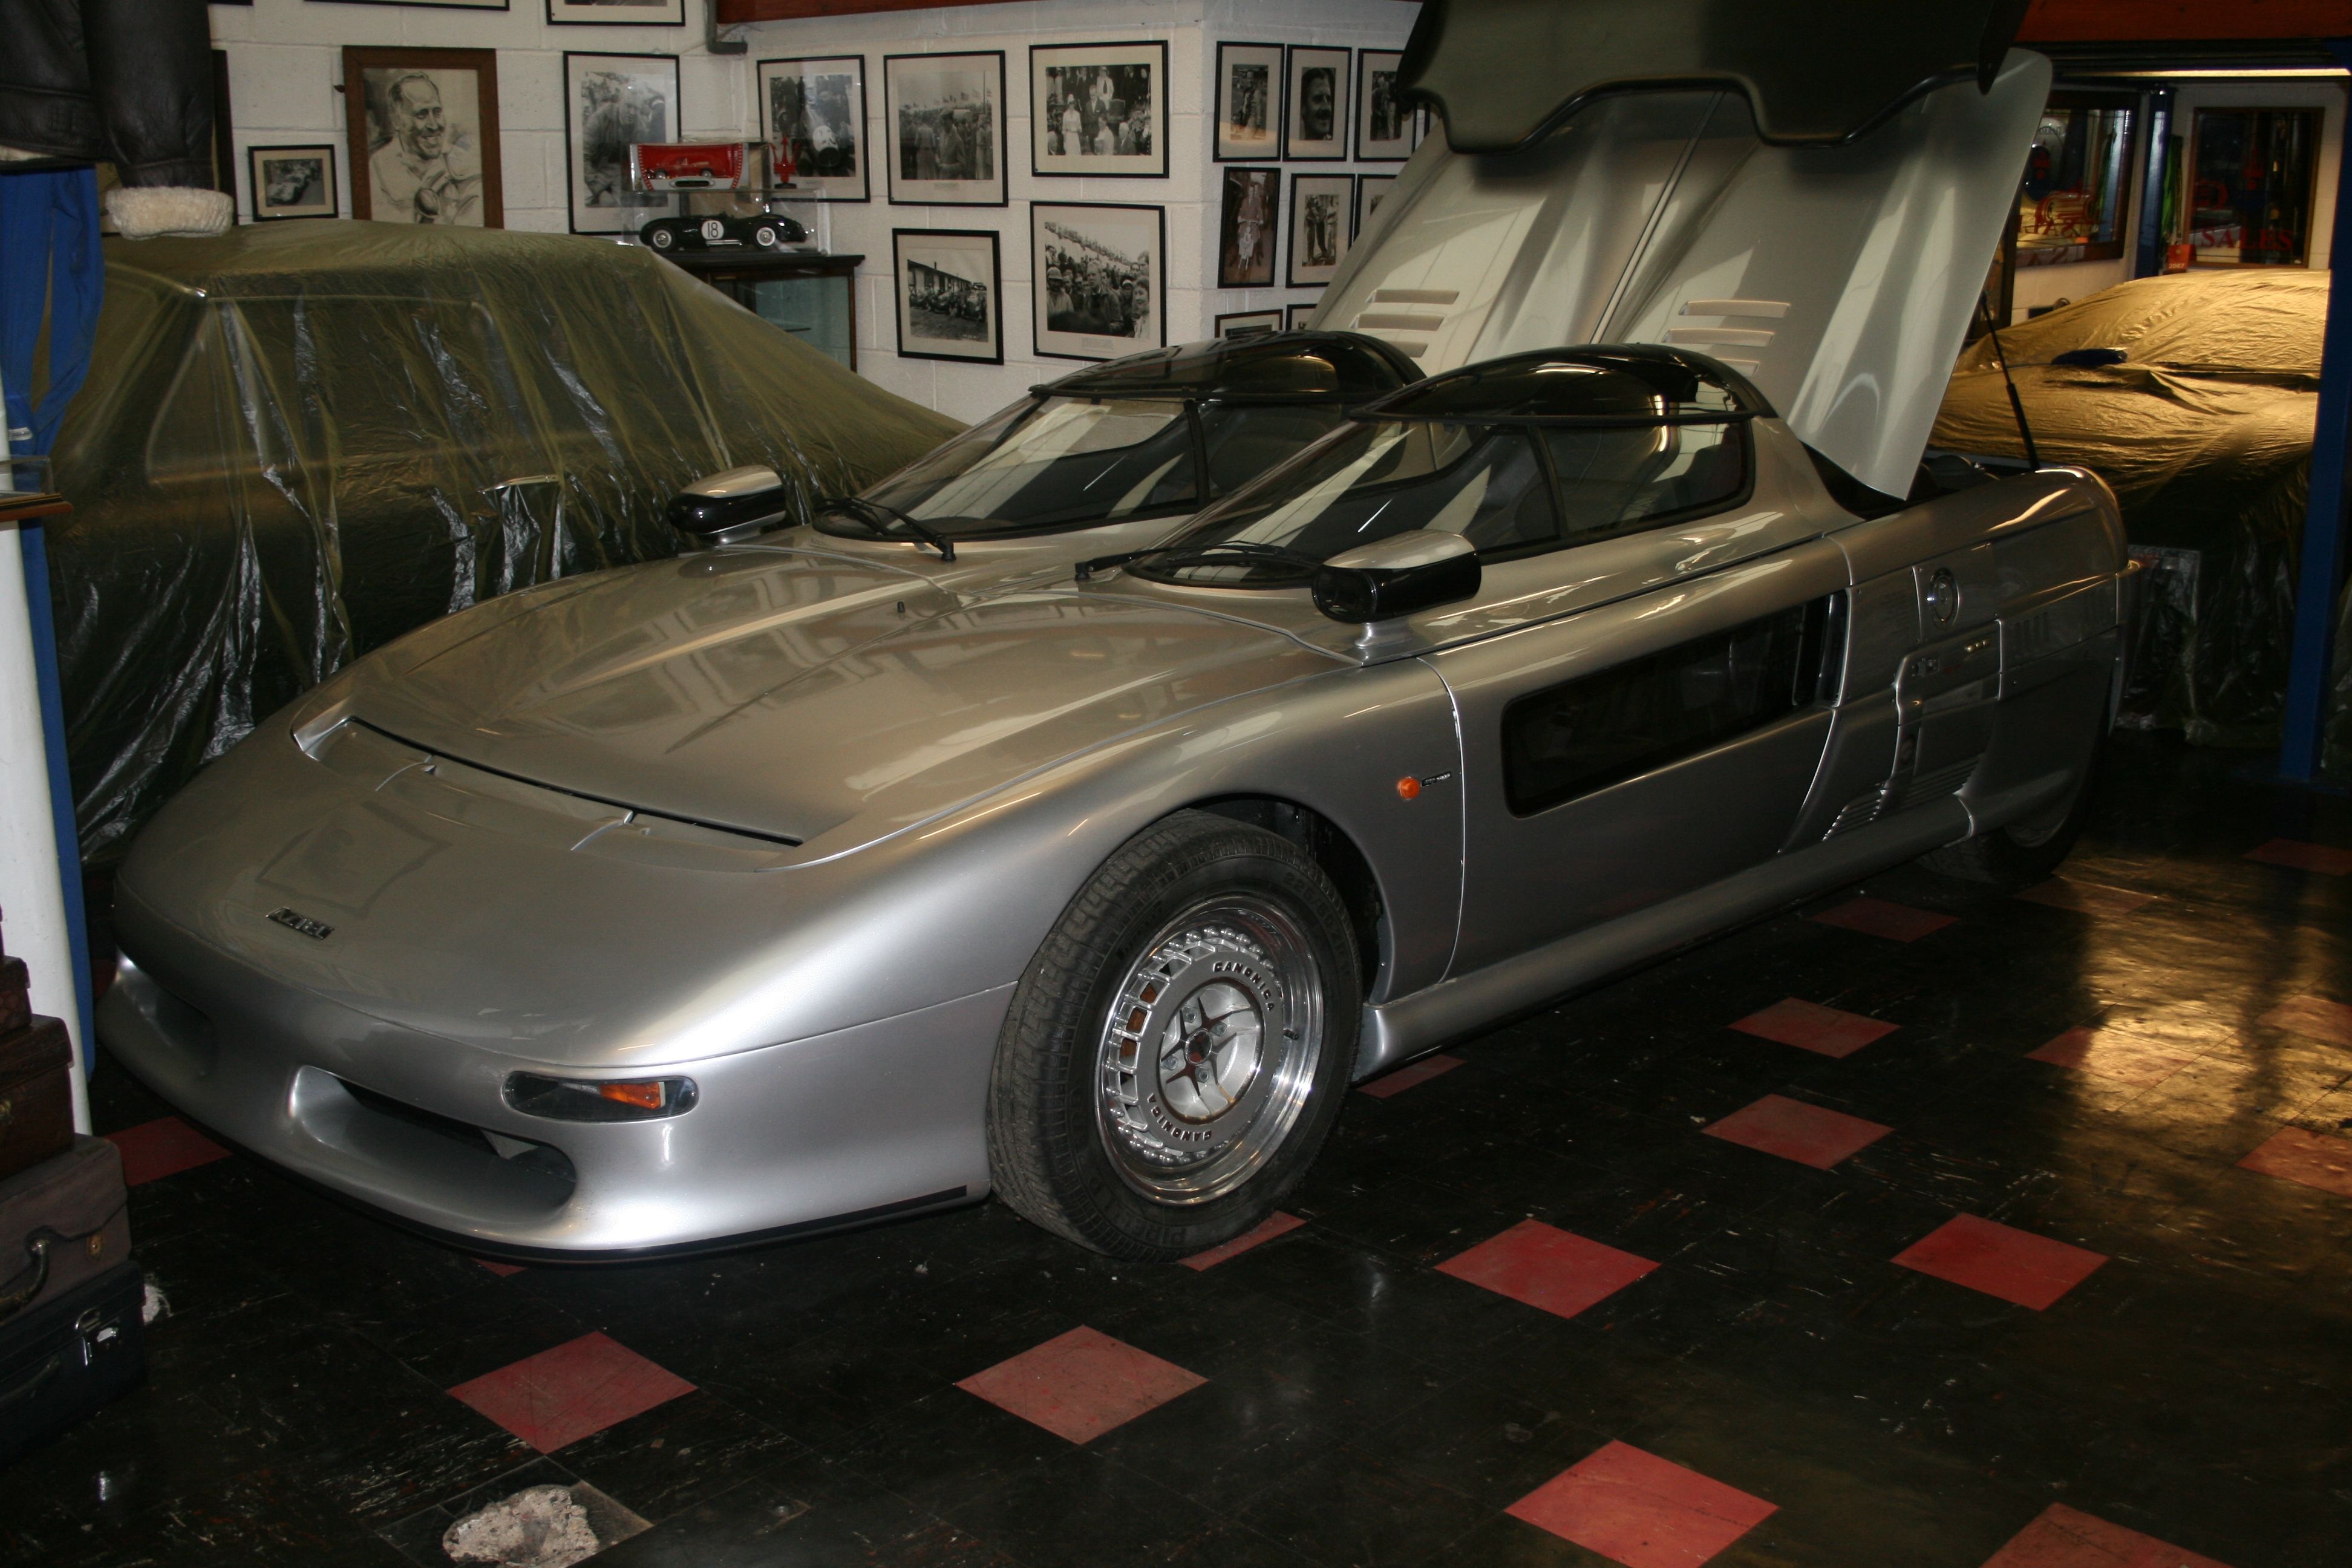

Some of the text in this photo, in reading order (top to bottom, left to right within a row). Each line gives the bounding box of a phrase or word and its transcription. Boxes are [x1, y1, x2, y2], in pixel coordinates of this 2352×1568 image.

[707, 222, 719, 238] 18
[2200, 226, 2296, 251] SALES
[1212, 961, 1275, 1012] CANONICA
[1147, 1093, 1212, 1142] CANONICA
